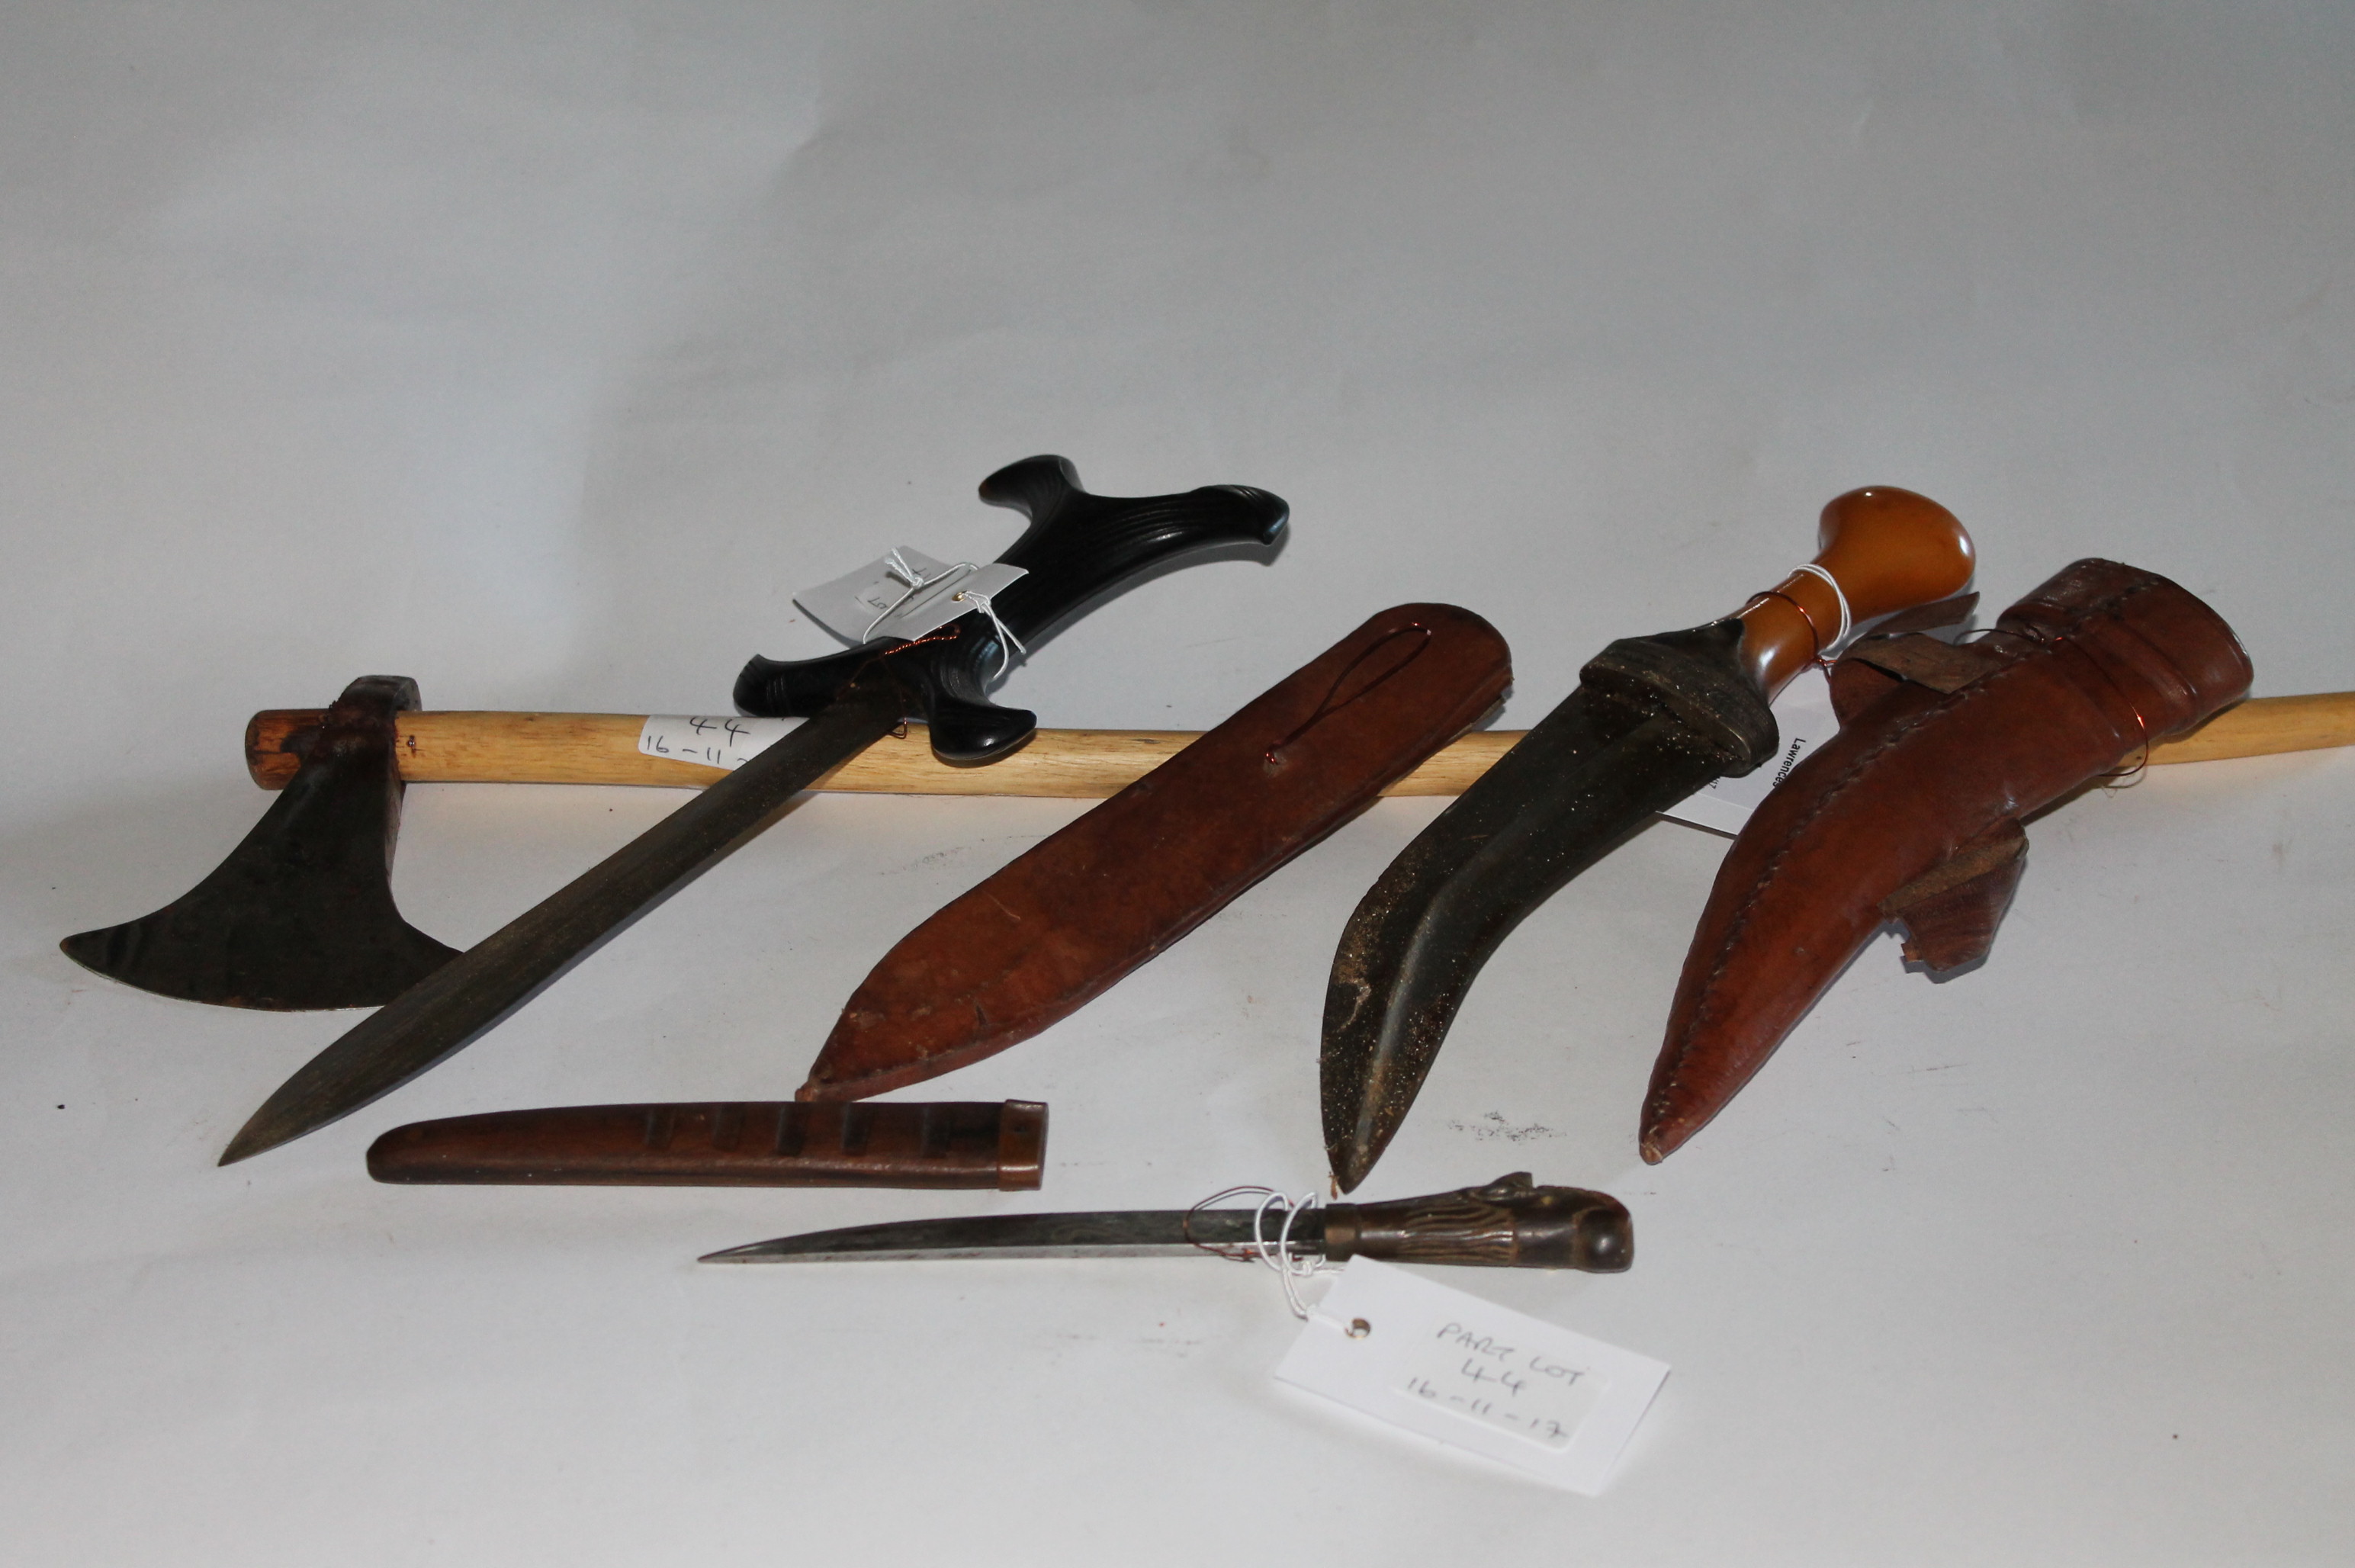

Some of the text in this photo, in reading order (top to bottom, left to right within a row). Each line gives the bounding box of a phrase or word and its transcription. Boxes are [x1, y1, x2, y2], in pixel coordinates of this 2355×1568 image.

[689, 716, 750, 747] 44
[1772, 737, 1807, 788] Lawrences
[1436, 1322, 1586, 1385] PART LOT
[1461, 1358, 1525, 1396] 44
